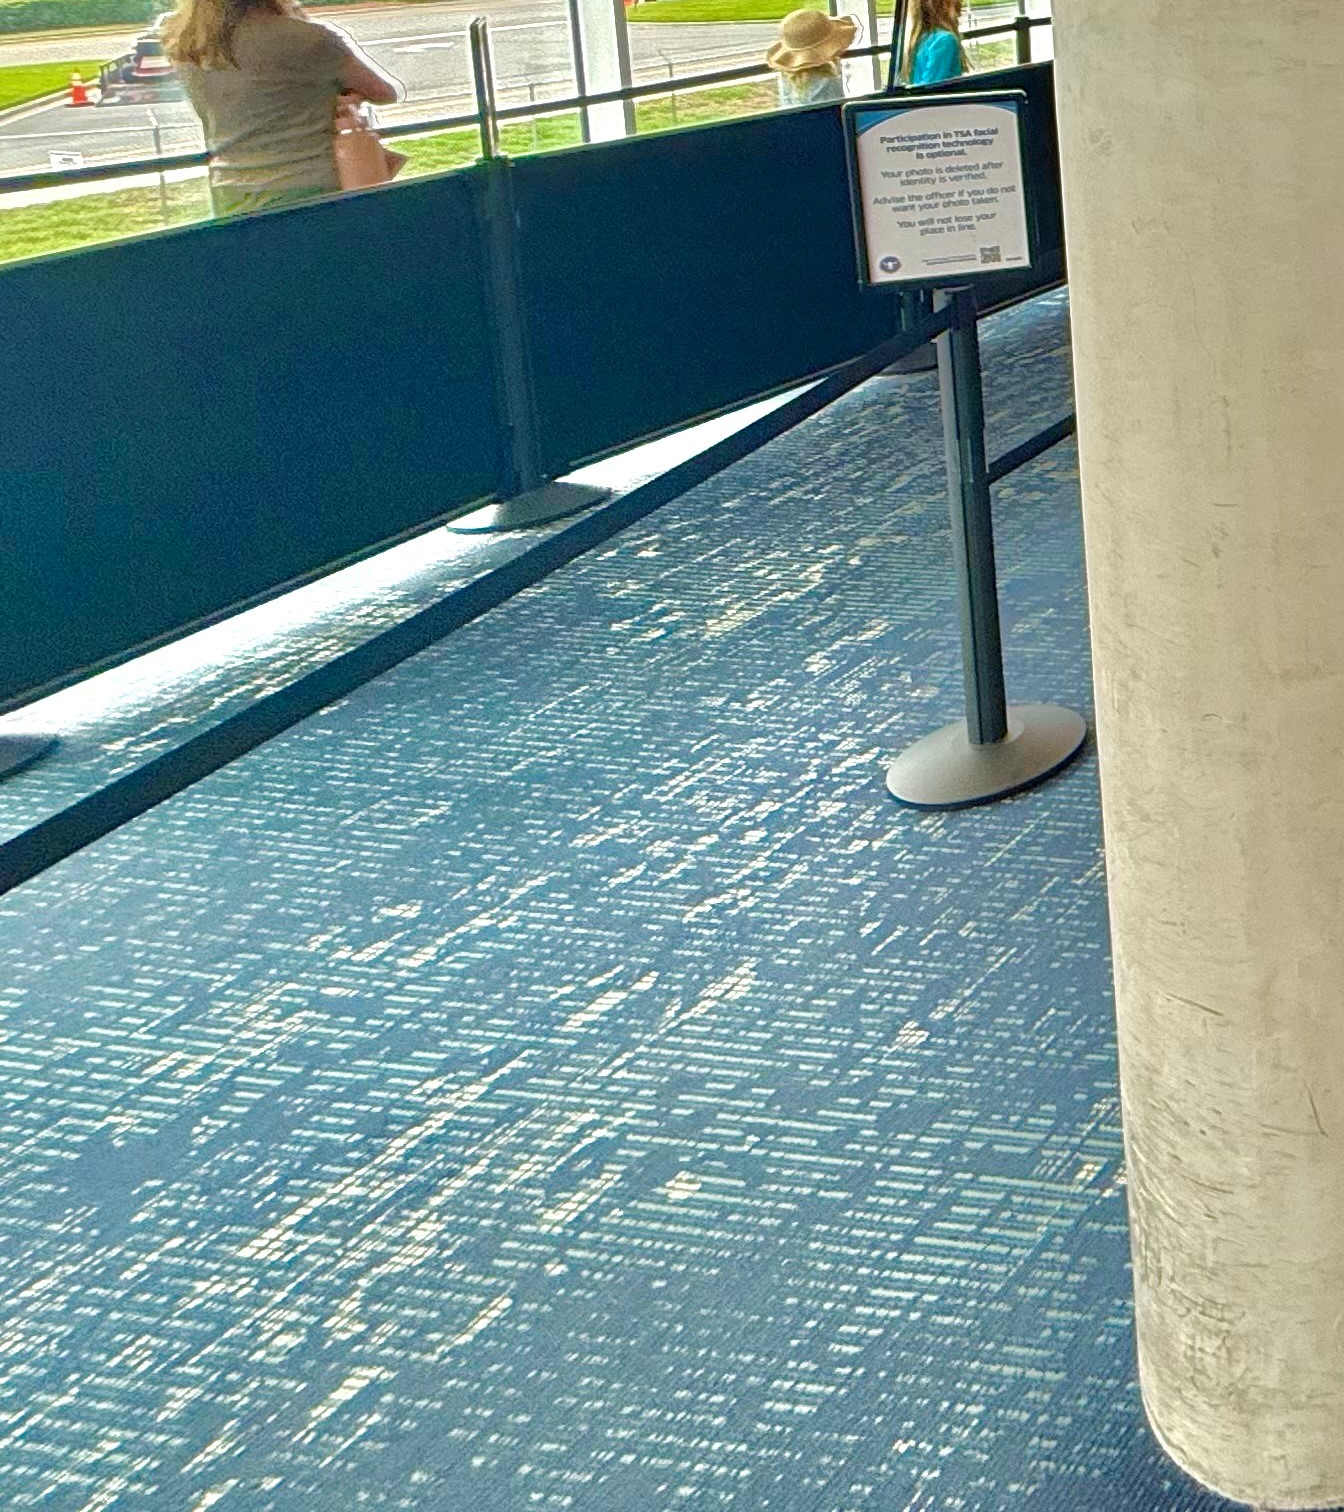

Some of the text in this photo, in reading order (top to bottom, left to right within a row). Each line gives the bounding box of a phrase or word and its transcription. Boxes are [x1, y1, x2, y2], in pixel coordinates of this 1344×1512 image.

[880, 133, 941, 144] Participation
[953, 130, 972, 138] TSA
[974, 128, 998, 136] facial
[887, 138, 993, 153] recognition technology
[881, 170, 903, 179] Your
[906, 169, 933, 178] photo
[945, 163, 980, 173] deleted
[981, 161, 1003, 170] after
[901, 176, 936, 186] identity
[939, 175, 947, 183] is
[873, 195, 905, 205] Advise
[908, 194, 923, 202] the
[925, 191, 955, 200] officer
[958, 189, 964, 197] if
[967, 189, 984, 197] you
[1001, 185, 1016, 193] not
[918, 202, 939, 211] your
[943, 198, 969, 208] photo
[918, 218, 935, 226] will
[937, 216, 952, 224] not
[976, 213, 996, 222] your
[920, 227, 945, 236] place
